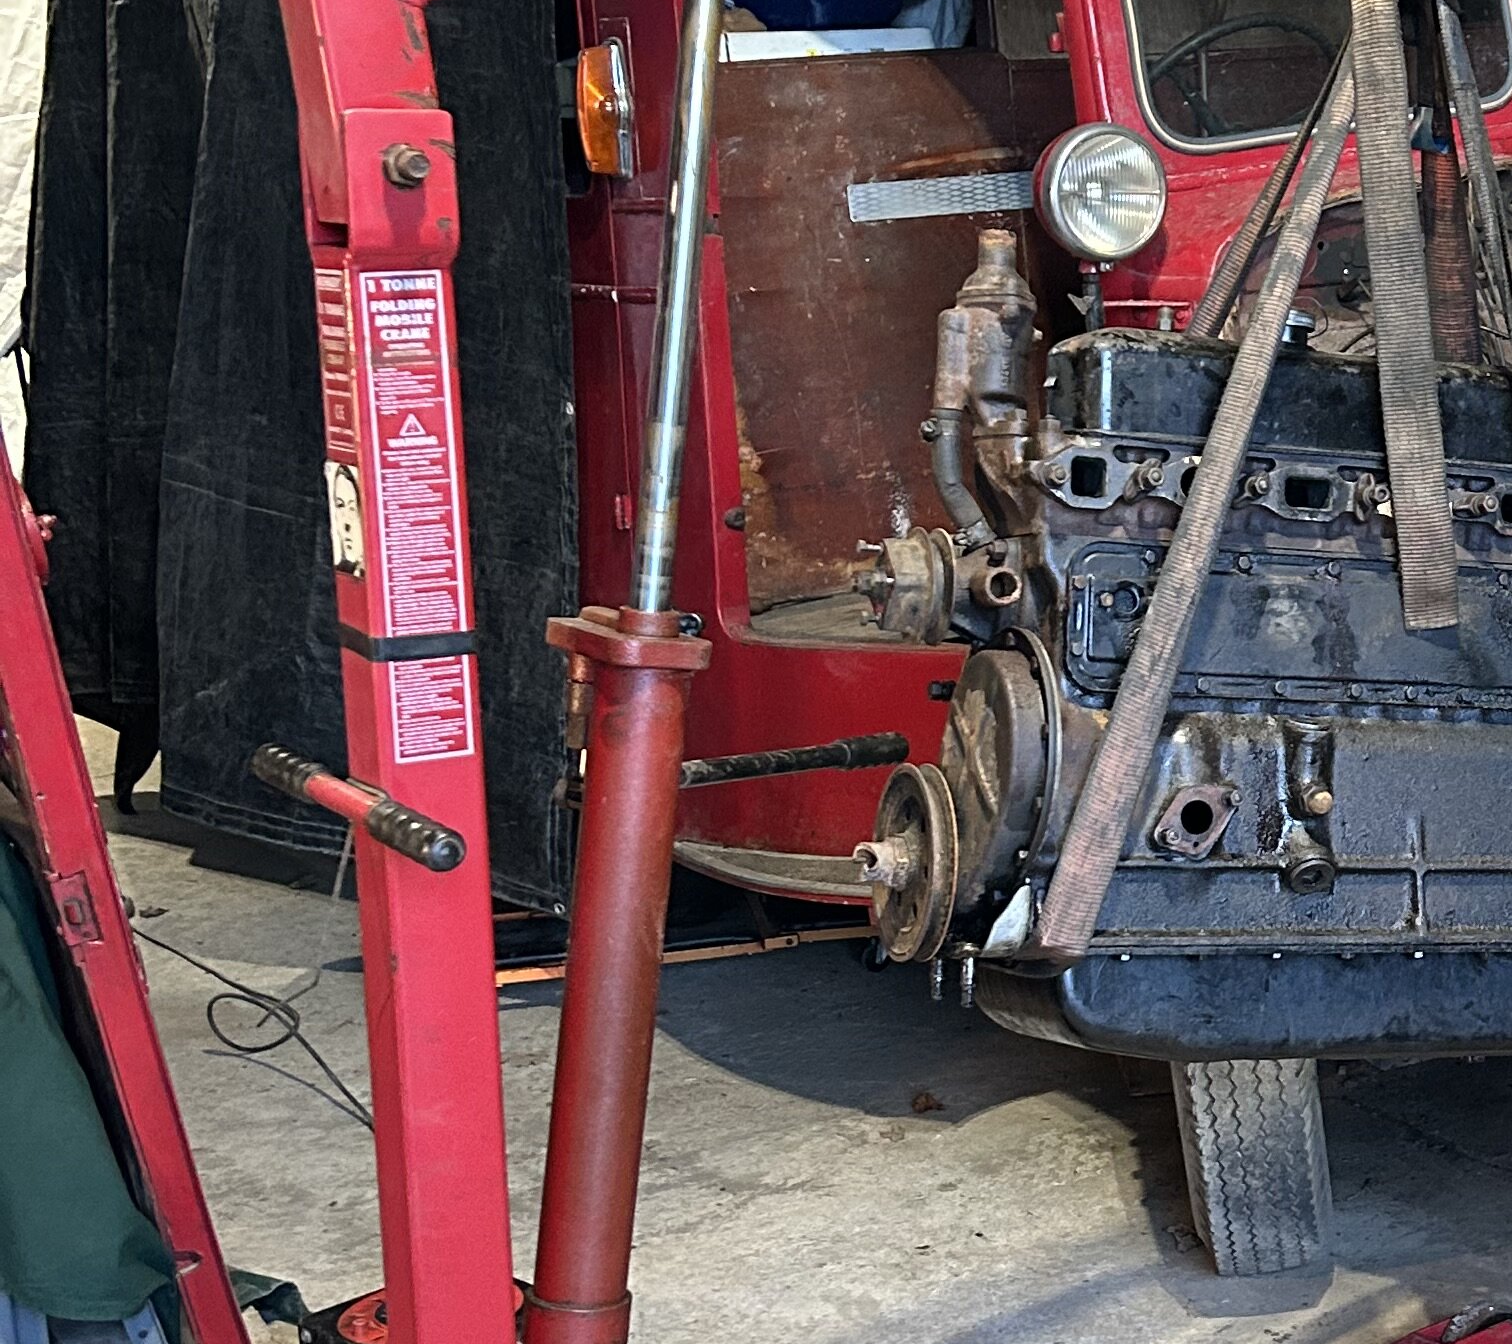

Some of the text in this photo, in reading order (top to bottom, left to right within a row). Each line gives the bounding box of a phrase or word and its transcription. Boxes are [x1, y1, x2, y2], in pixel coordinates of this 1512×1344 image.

[380, 277, 437, 292] TONNE
[369, 297, 436, 313] FOLDING
[374, 312, 434, 327] MOBILE
[380, 327, 431, 341] CRANE
